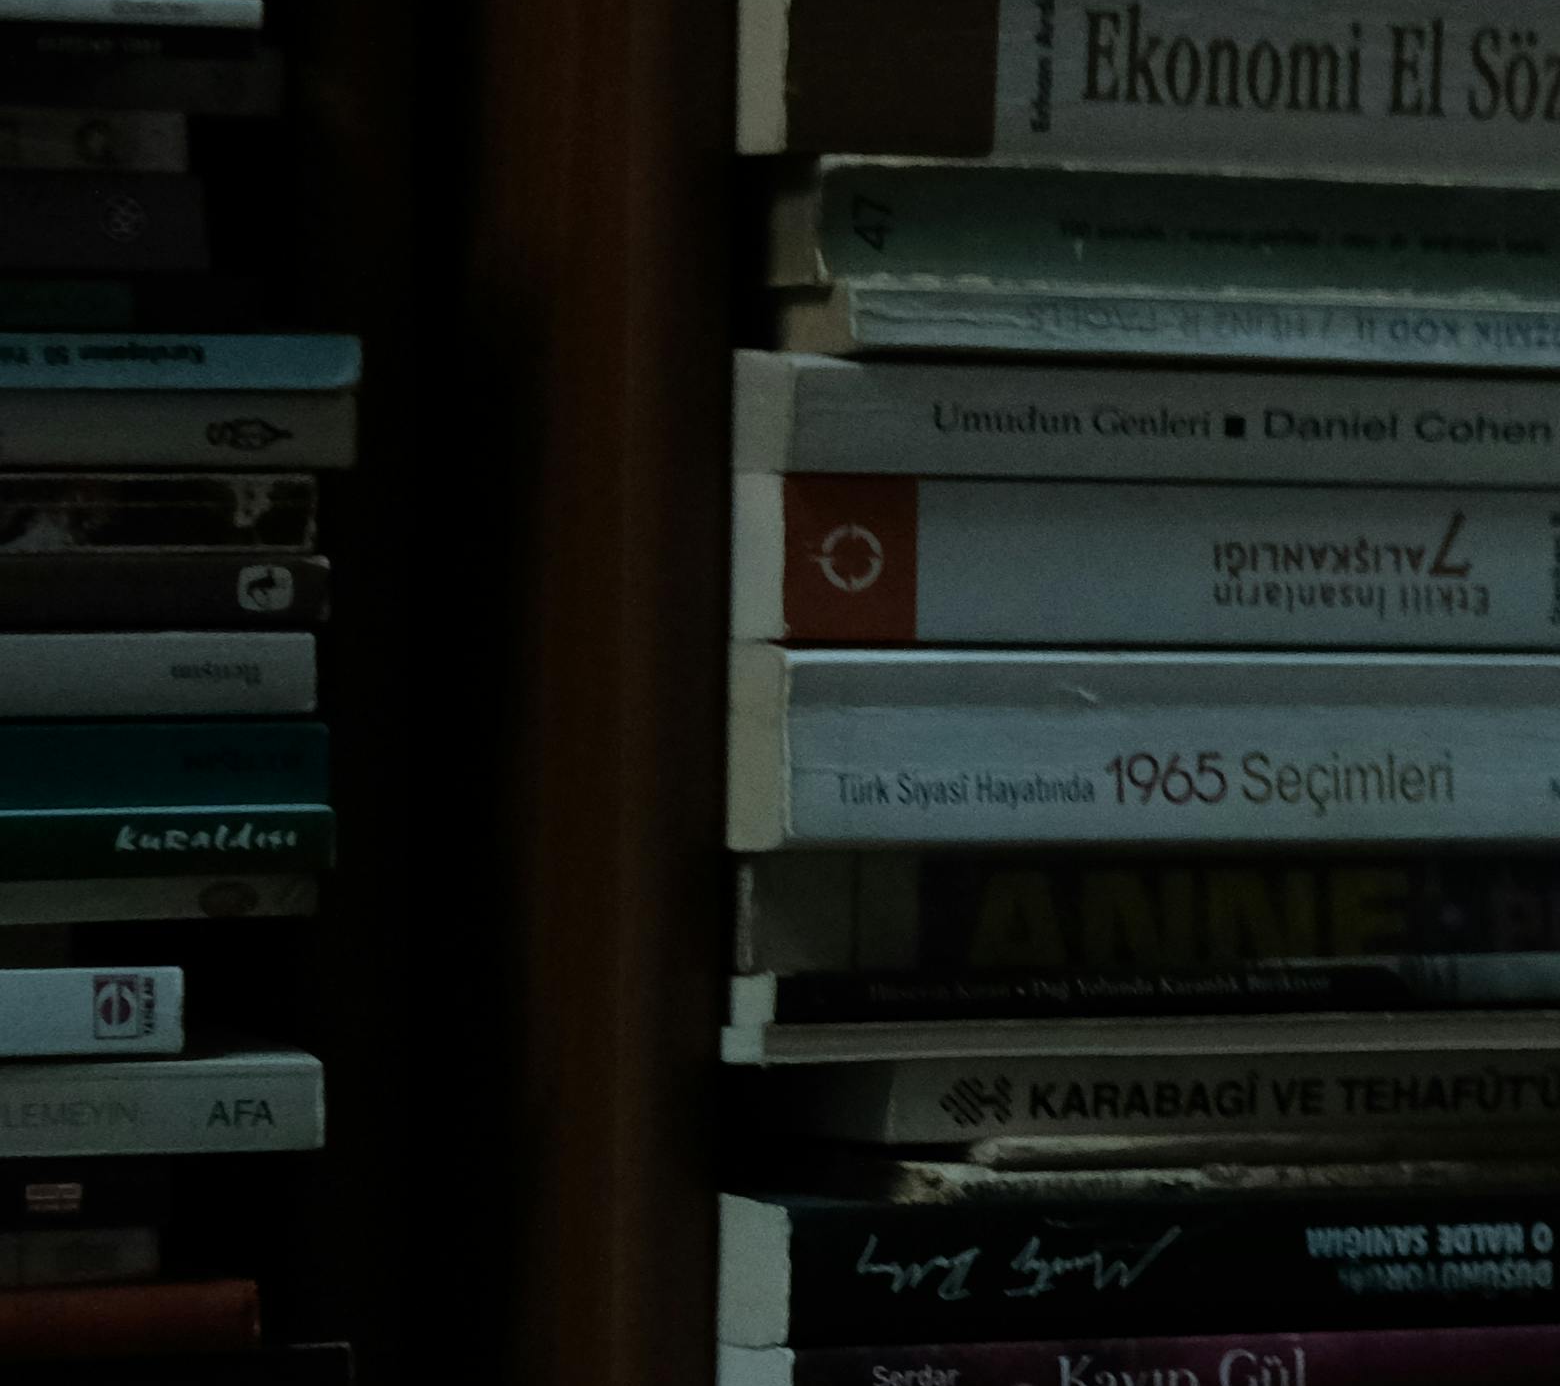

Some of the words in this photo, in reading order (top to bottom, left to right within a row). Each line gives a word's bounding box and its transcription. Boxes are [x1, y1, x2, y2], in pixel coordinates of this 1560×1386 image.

[1083, 7, 1366, 116] Ekonomi
[1388, 19, 1447, 115] El
[930, 402, 1082, 437] Umudun
[1089, 403, 1213, 438] Genleri
[1261, 409, 1401, 444] Daniel
[1413, 412, 1553, 445] Cohen
[1211, 533, 1426, 585] ALIŞKANLIĞI
[1428, 508, 1472, 581] 7
[1397, 583, 1491, 619] Etkili
[837, 770, 891, 805] Türk
[975, 769, 1096, 812] Hayatında
[1106, 749, 1230, 805] 1965
[1240, 748, 1456, 818] Seçimleri
[966, 866, 1414, 969] ANNE
[206, 1097, 276, 1128] AFA
[1272, 1076, 1325, 1117] VE
[1436, 1222, 1525, 1254] HALDE
